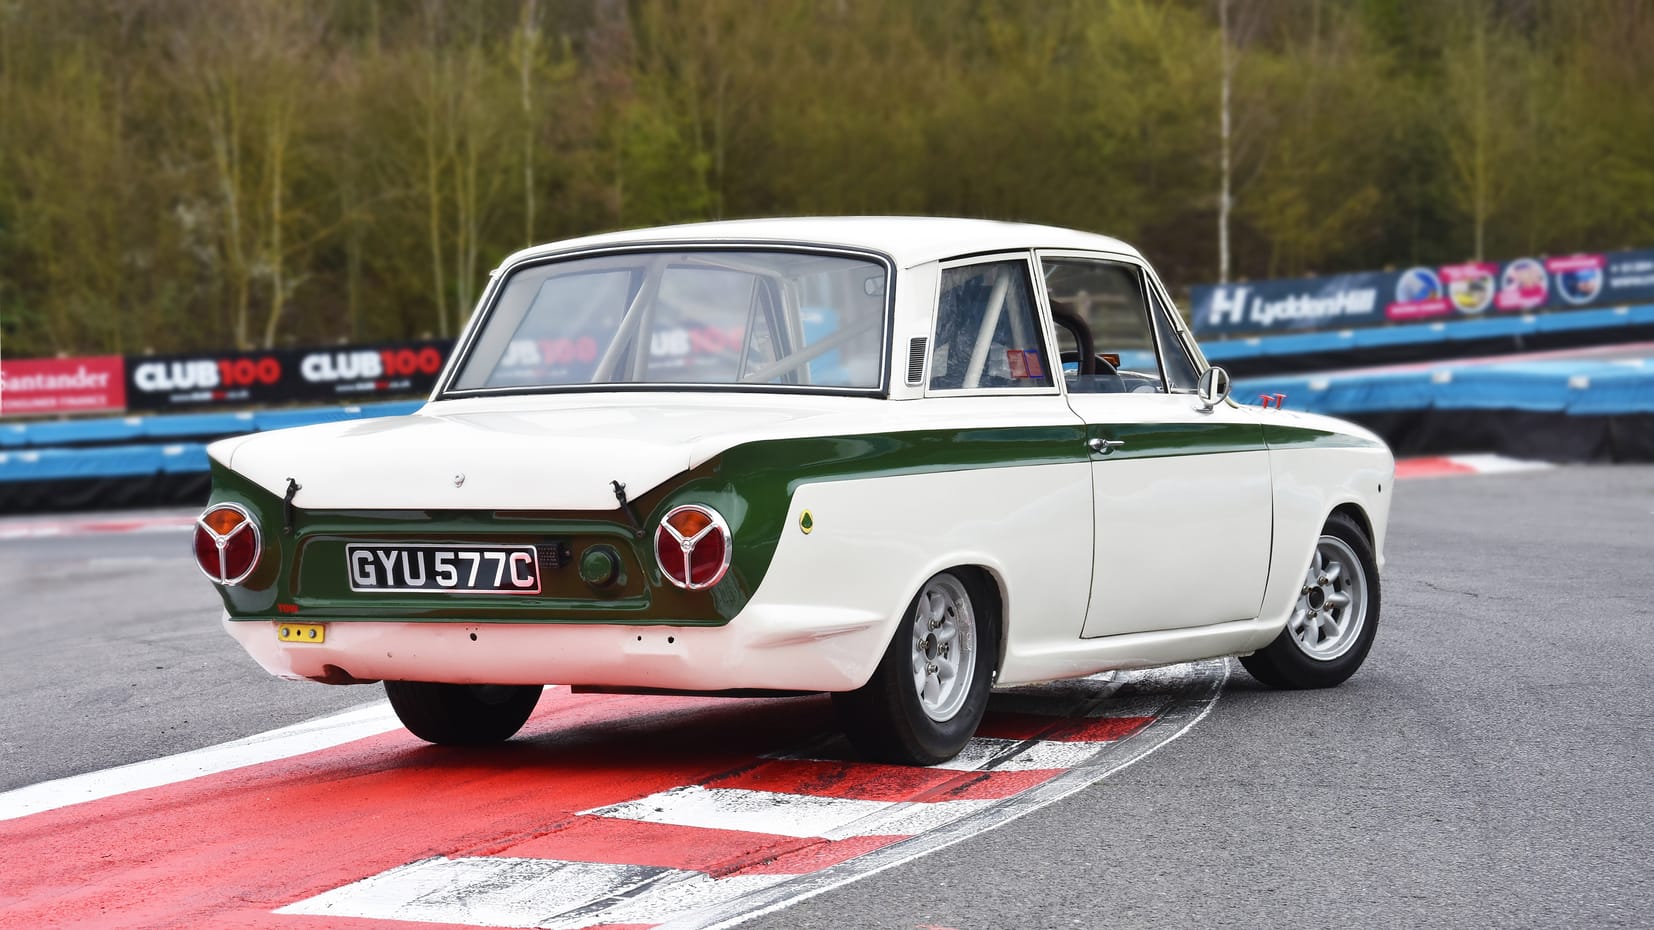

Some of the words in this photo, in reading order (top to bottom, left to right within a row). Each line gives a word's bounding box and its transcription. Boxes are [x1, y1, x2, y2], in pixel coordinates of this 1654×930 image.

[0, 365, 109, 390] Santander
[135, 357, 281, 390] CLUB100
[302, 348, 440, 381] CLUB100
[351, 550, 426, 586] GYU
[435, 551, 535, 588] 577C
